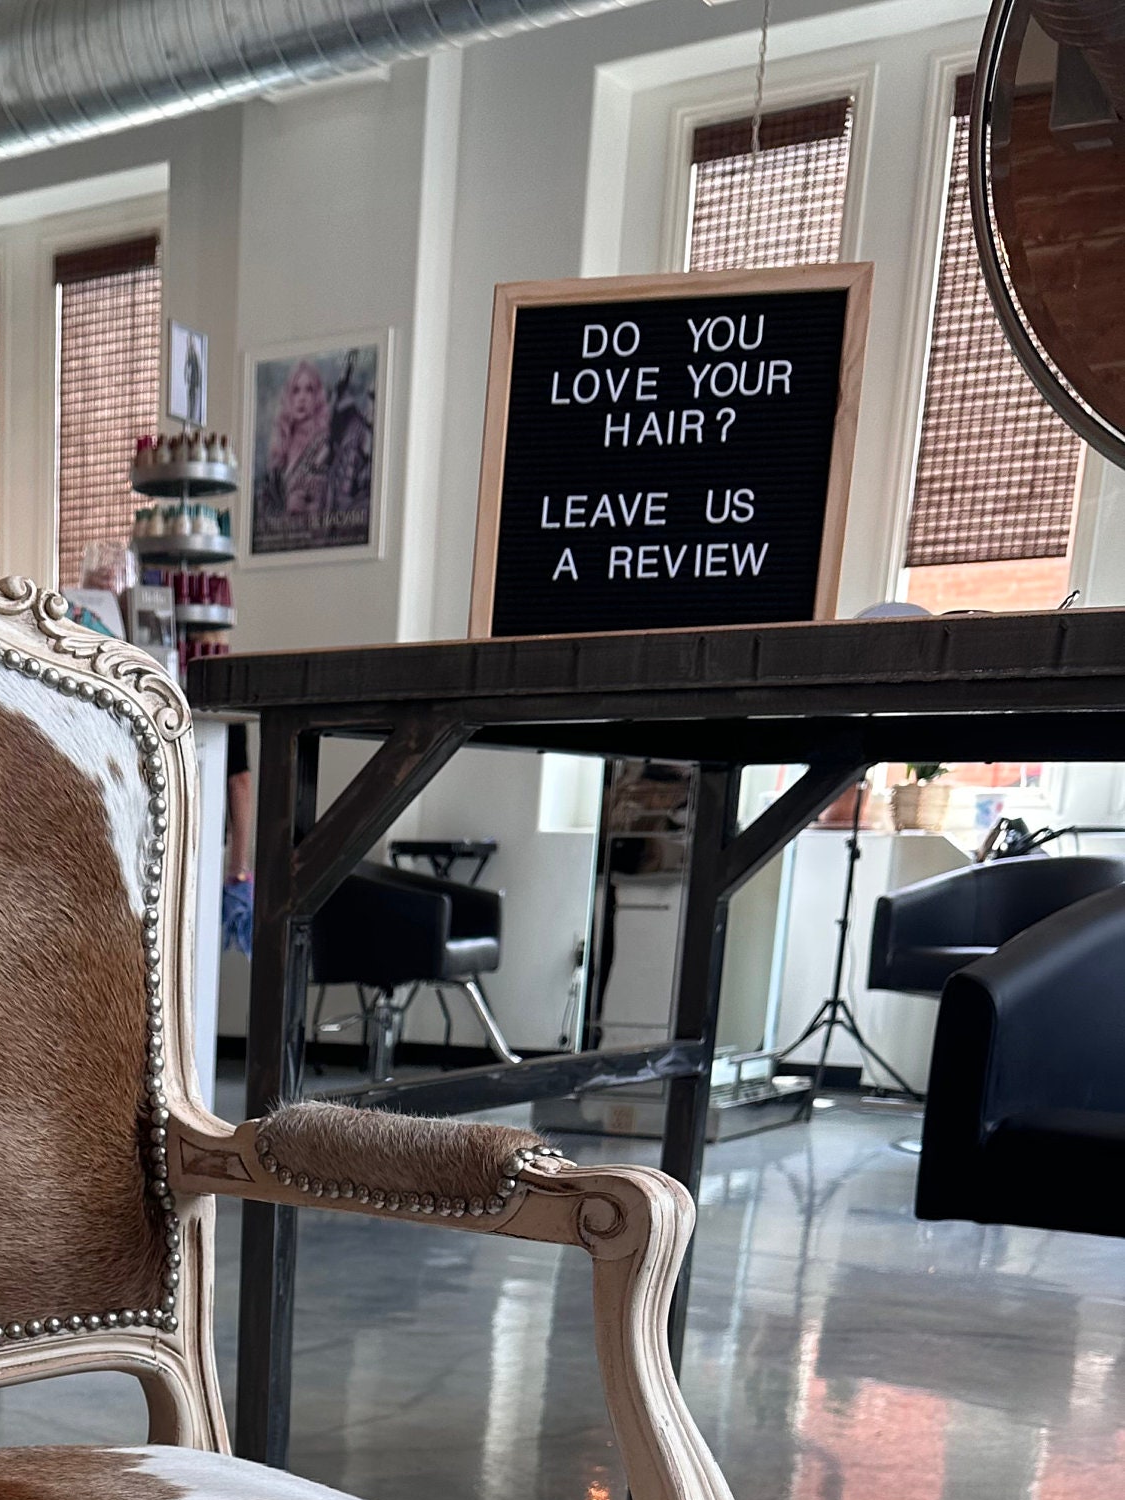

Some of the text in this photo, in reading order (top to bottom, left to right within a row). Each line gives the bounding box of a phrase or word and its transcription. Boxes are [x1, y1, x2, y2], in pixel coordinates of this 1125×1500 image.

[581, 314, 765, 358] DO YOU
[551, 359, 793, 404] LOVE YOUR
[603, 407, 737, 447] HAIR?
[540, 488, 755, 529] LEAVE US
[552, 542, 769, 581] A REVIEW
